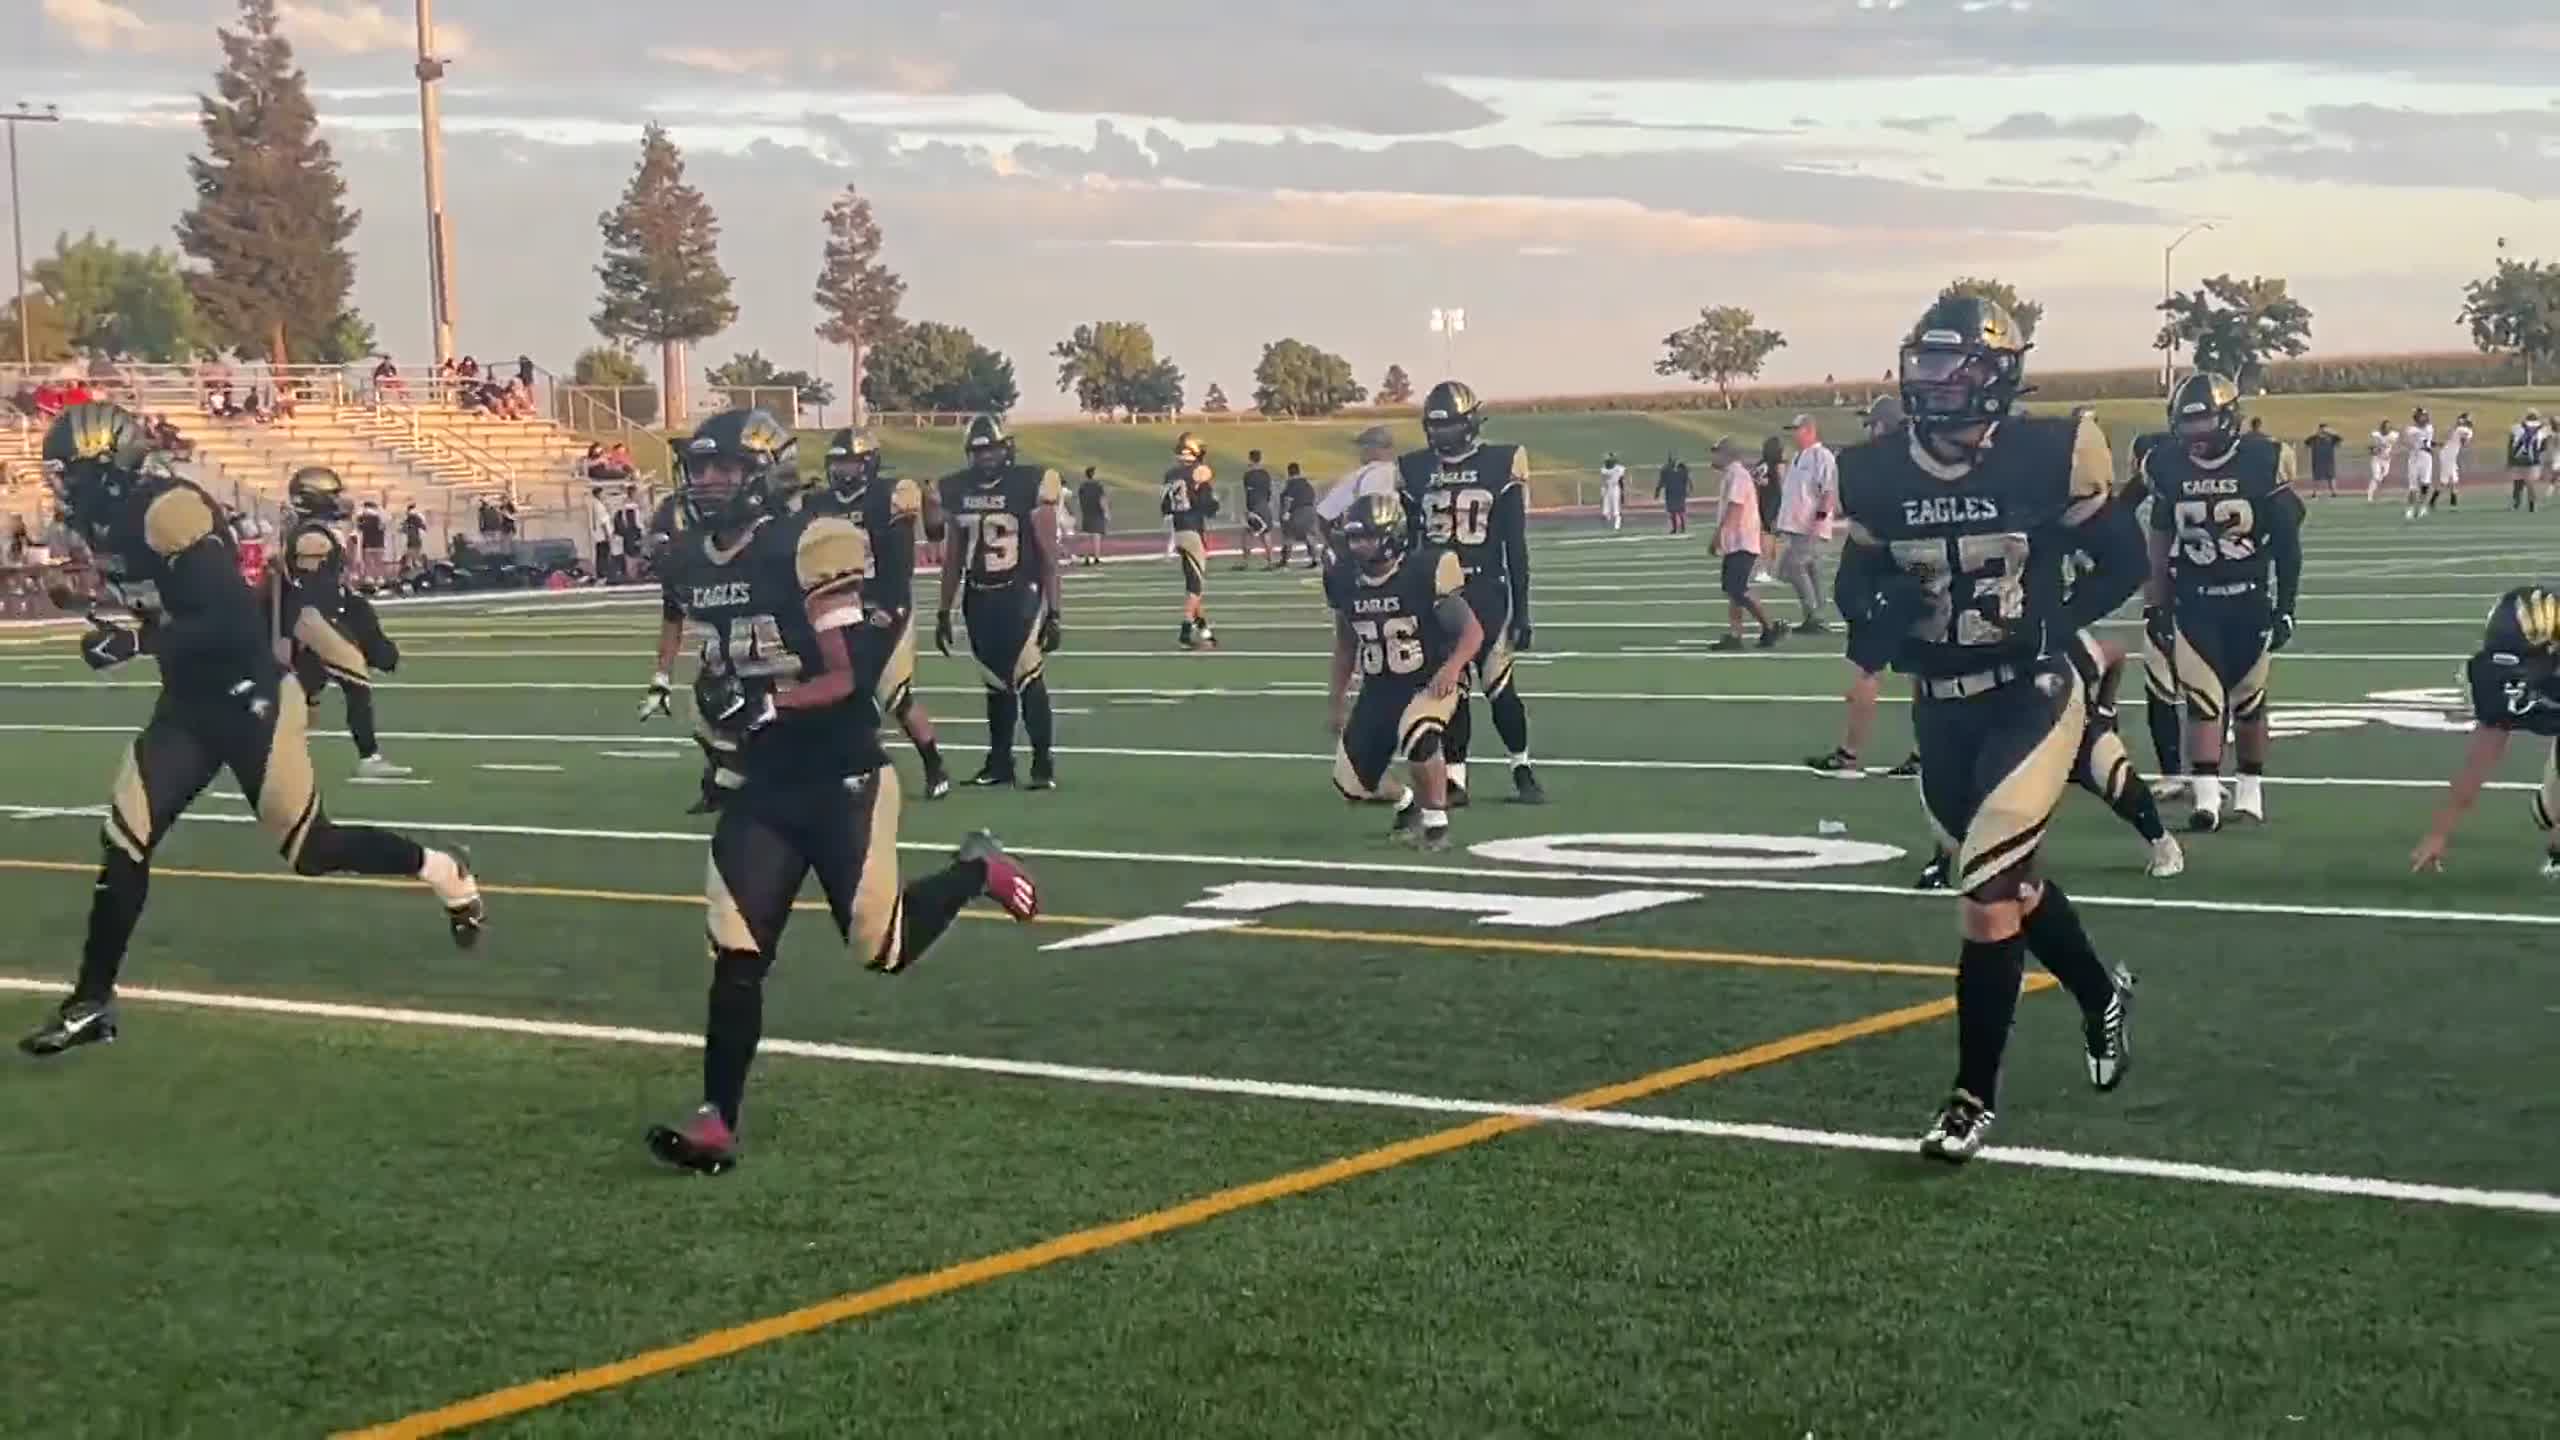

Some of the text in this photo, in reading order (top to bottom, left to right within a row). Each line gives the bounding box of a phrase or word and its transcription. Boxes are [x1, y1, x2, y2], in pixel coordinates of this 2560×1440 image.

[2182, 480, 2239, 495] EAGLES
[1902, 497, 1999, 526] EAGLES
[956, 512, 1019, 572] 79
[692, 582, 751, 608] EAGLES
